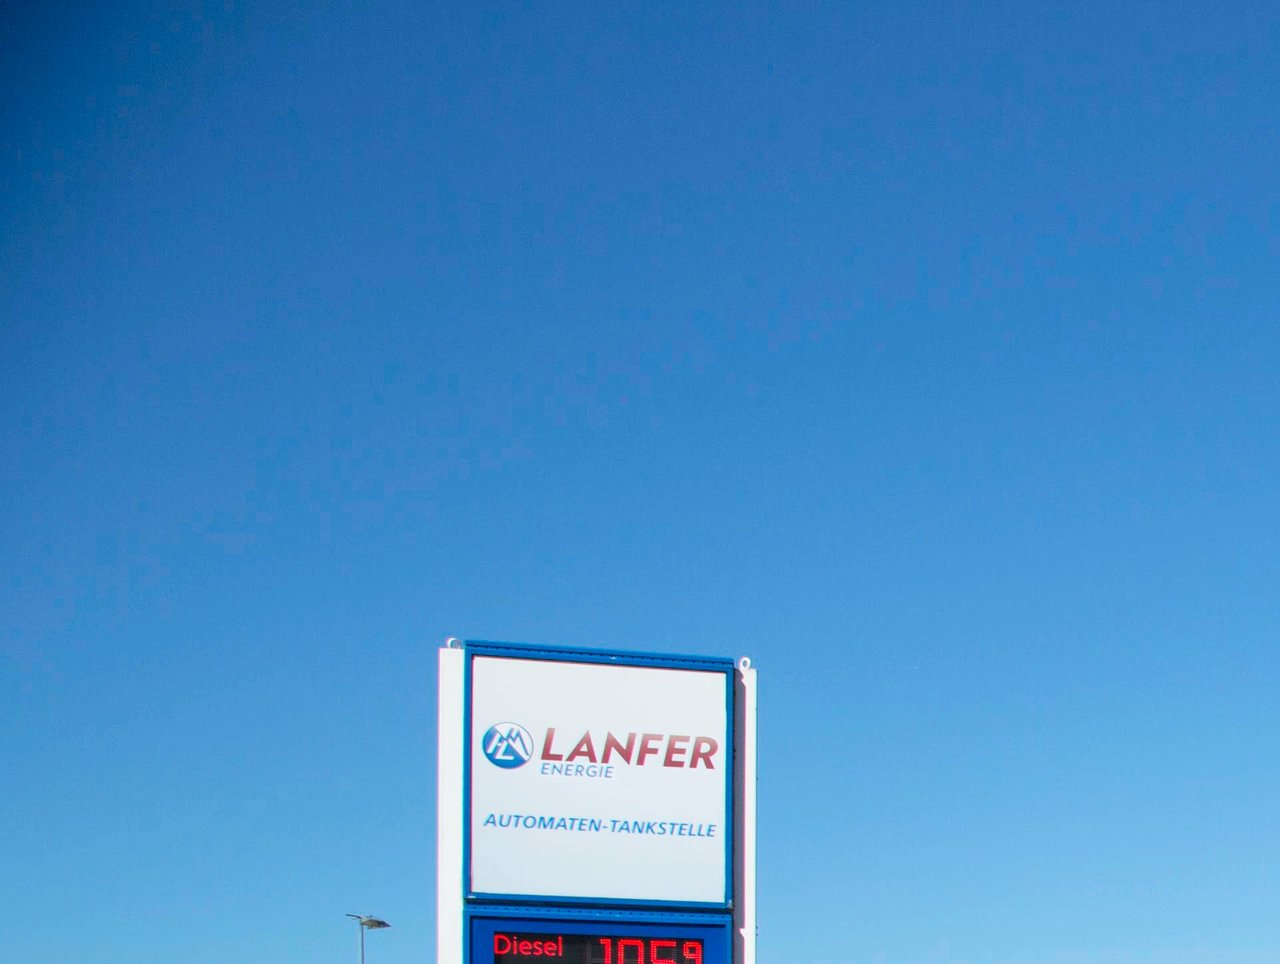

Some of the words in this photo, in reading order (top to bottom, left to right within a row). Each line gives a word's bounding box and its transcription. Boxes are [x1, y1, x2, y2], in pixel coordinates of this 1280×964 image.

[540, 727, 719, 770] LANFER
[540, 763, 615, 779] ENERGIE
[483, 813, 718, 838] AUTOMATEN-TANKSTELLE
[494, 934, 563, 956] Diesel
